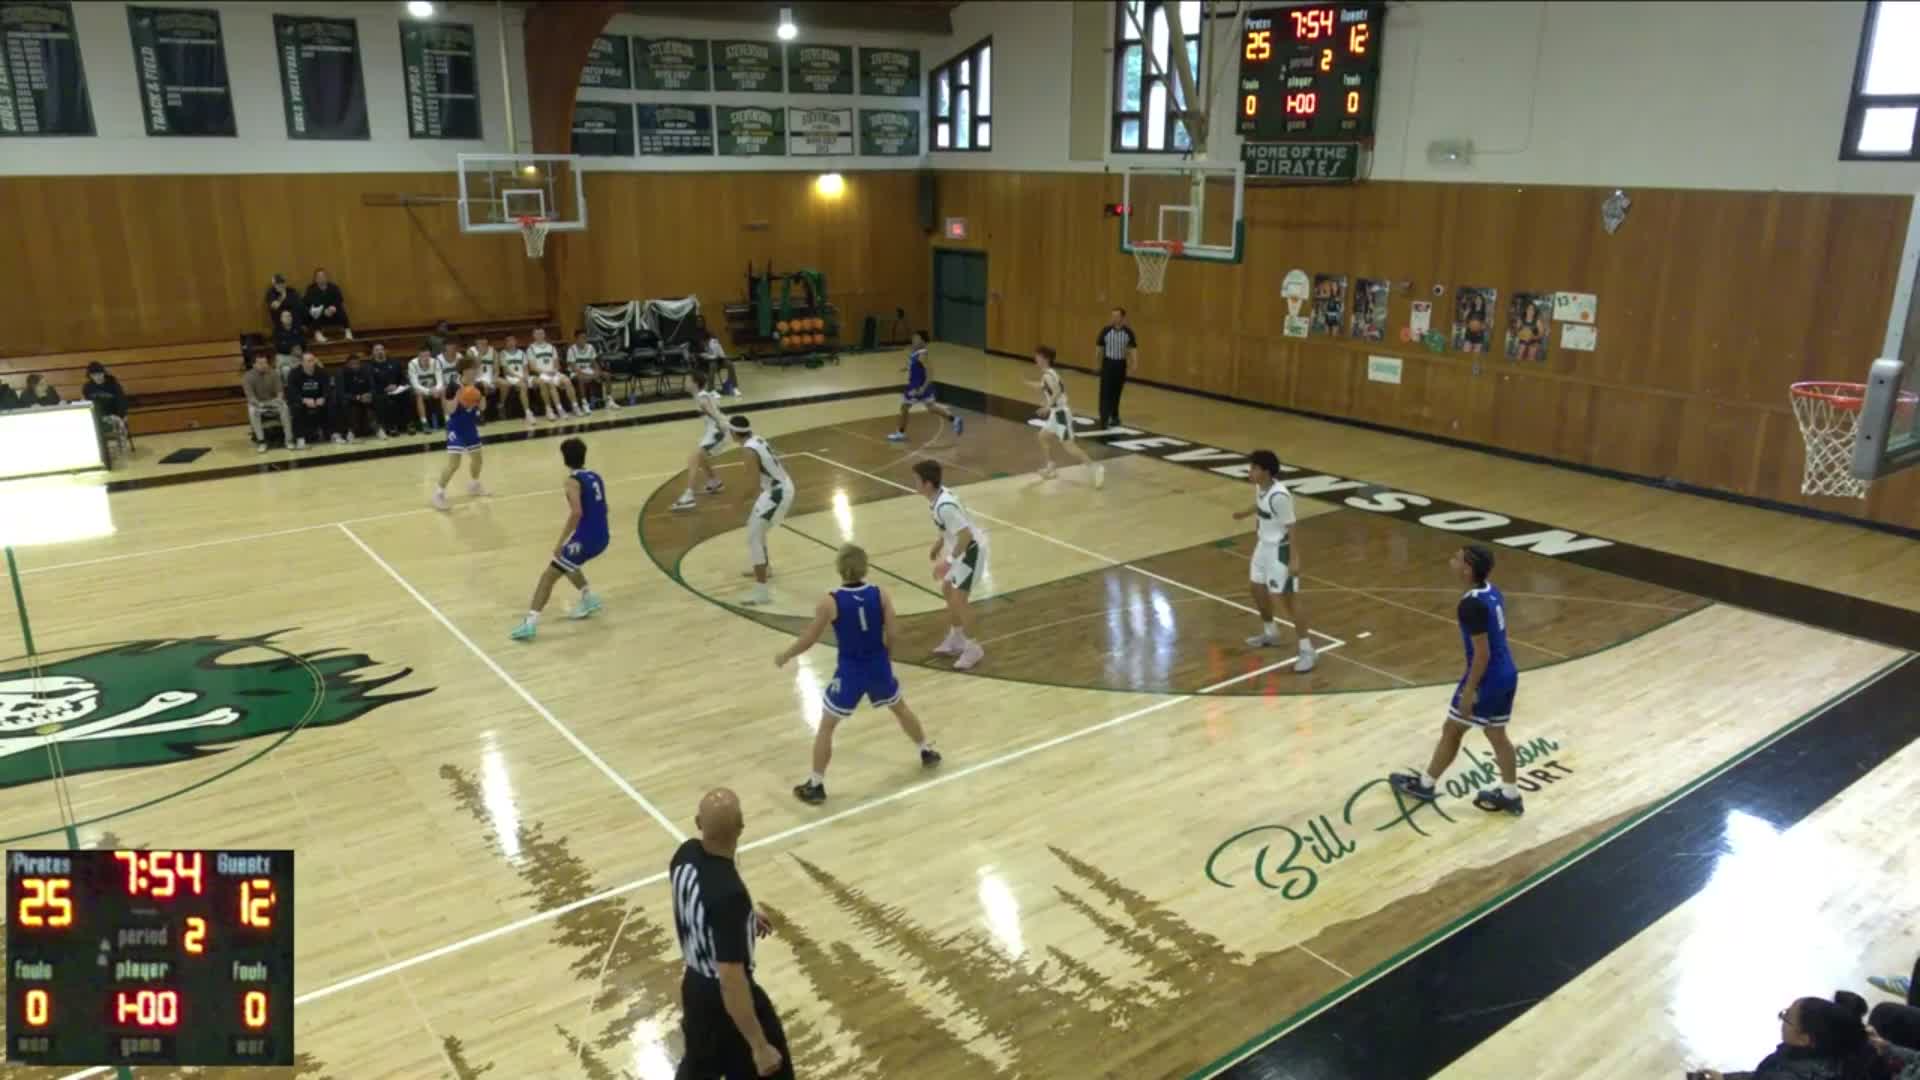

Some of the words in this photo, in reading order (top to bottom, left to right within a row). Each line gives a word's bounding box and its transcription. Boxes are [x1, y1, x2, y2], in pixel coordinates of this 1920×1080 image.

[1291, 10, 1333, 38] 7:54
[1246, 31, 1270, 59] 25
[1349, 23, 1368, 53] 12
[141, 47, 159, 81] FIELD
[1321, 49, 1332, 71] 2
[148, 93, 167, 131] TRACK
[1246, 95, 1257, 115] 0
[1347, 91, 1359, 113] 0
[1247, 147, 1287, 158] HOME
[1291, 147, 1310, 158] OF
[1314, 147, 1347, 158] THE
[1256, 160, 1342, 176] PIRATES
[858, 606, 868, 631] 1
[1205, 815, 1356, 900] Bill
